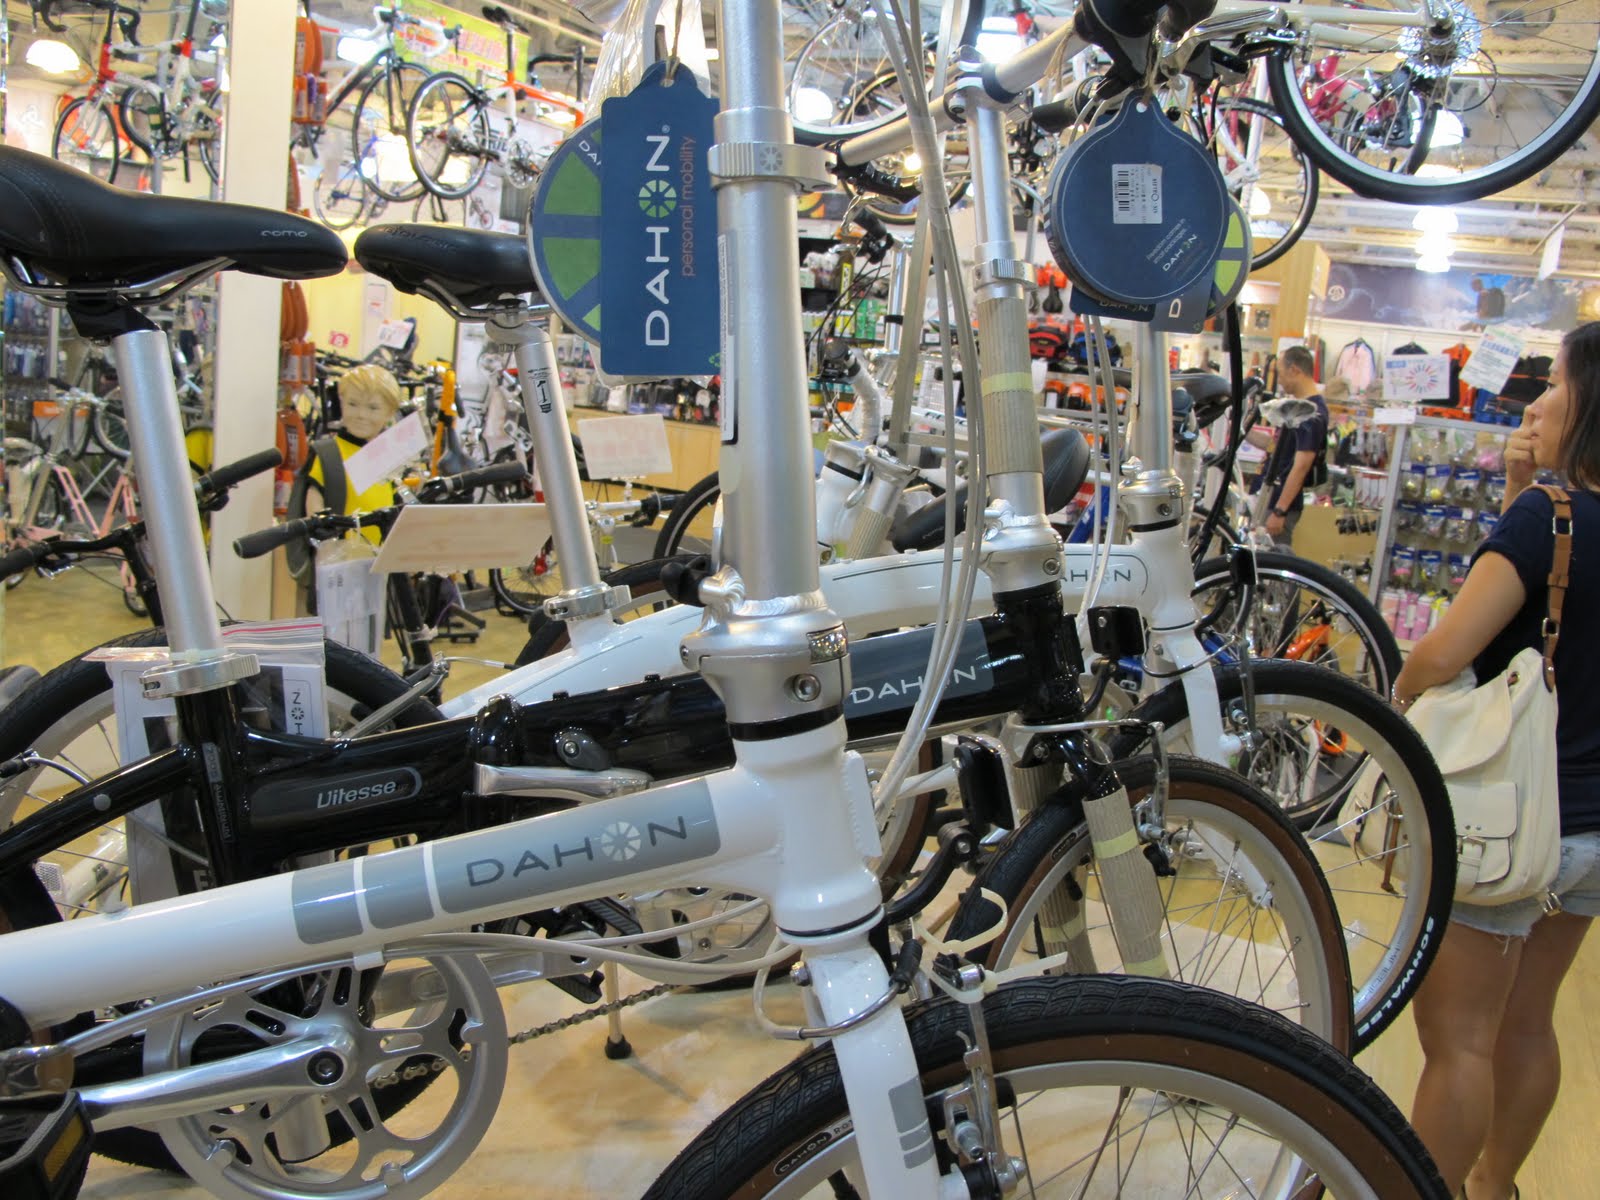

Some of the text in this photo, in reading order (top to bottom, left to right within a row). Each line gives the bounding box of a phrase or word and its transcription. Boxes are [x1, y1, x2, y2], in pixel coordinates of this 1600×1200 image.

[578, 140, 602, 166] DA
[679, 136, 696, 278] personal mobility
[639, 135, 677, 346] DAHON
[850, 665, 976, 704] DAHN
[317, 781, 396, 809] Vitesse
[466, 815, 688, 887] DAHON
[1357, 916, 1434, 1037] SCHWALBE
[779, 1136, 827, 1173] DAHON
